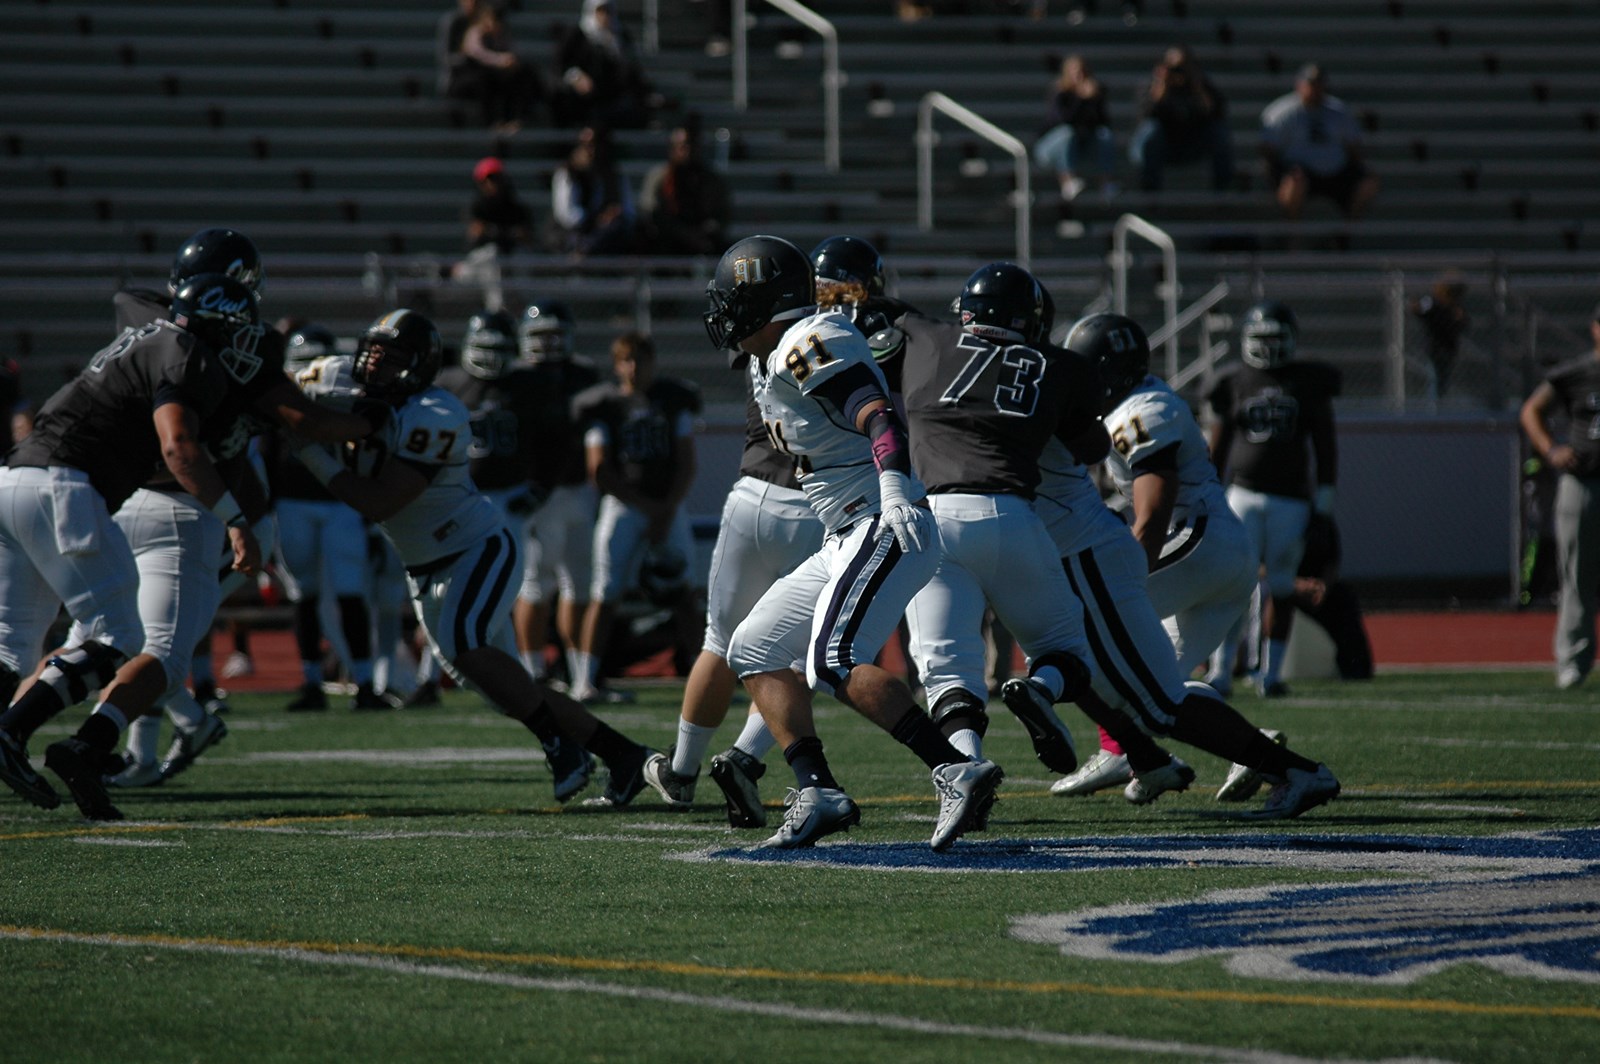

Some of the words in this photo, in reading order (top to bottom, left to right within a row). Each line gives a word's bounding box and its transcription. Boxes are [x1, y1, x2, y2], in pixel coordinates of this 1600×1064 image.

[734, 257, 768, 287] 91
[973, 326, 1008, 337] Riddell
[786, 332, 833, 382] 91
[938, 332, 1047, 418] 73
[406, 428, 456, 460] 97
